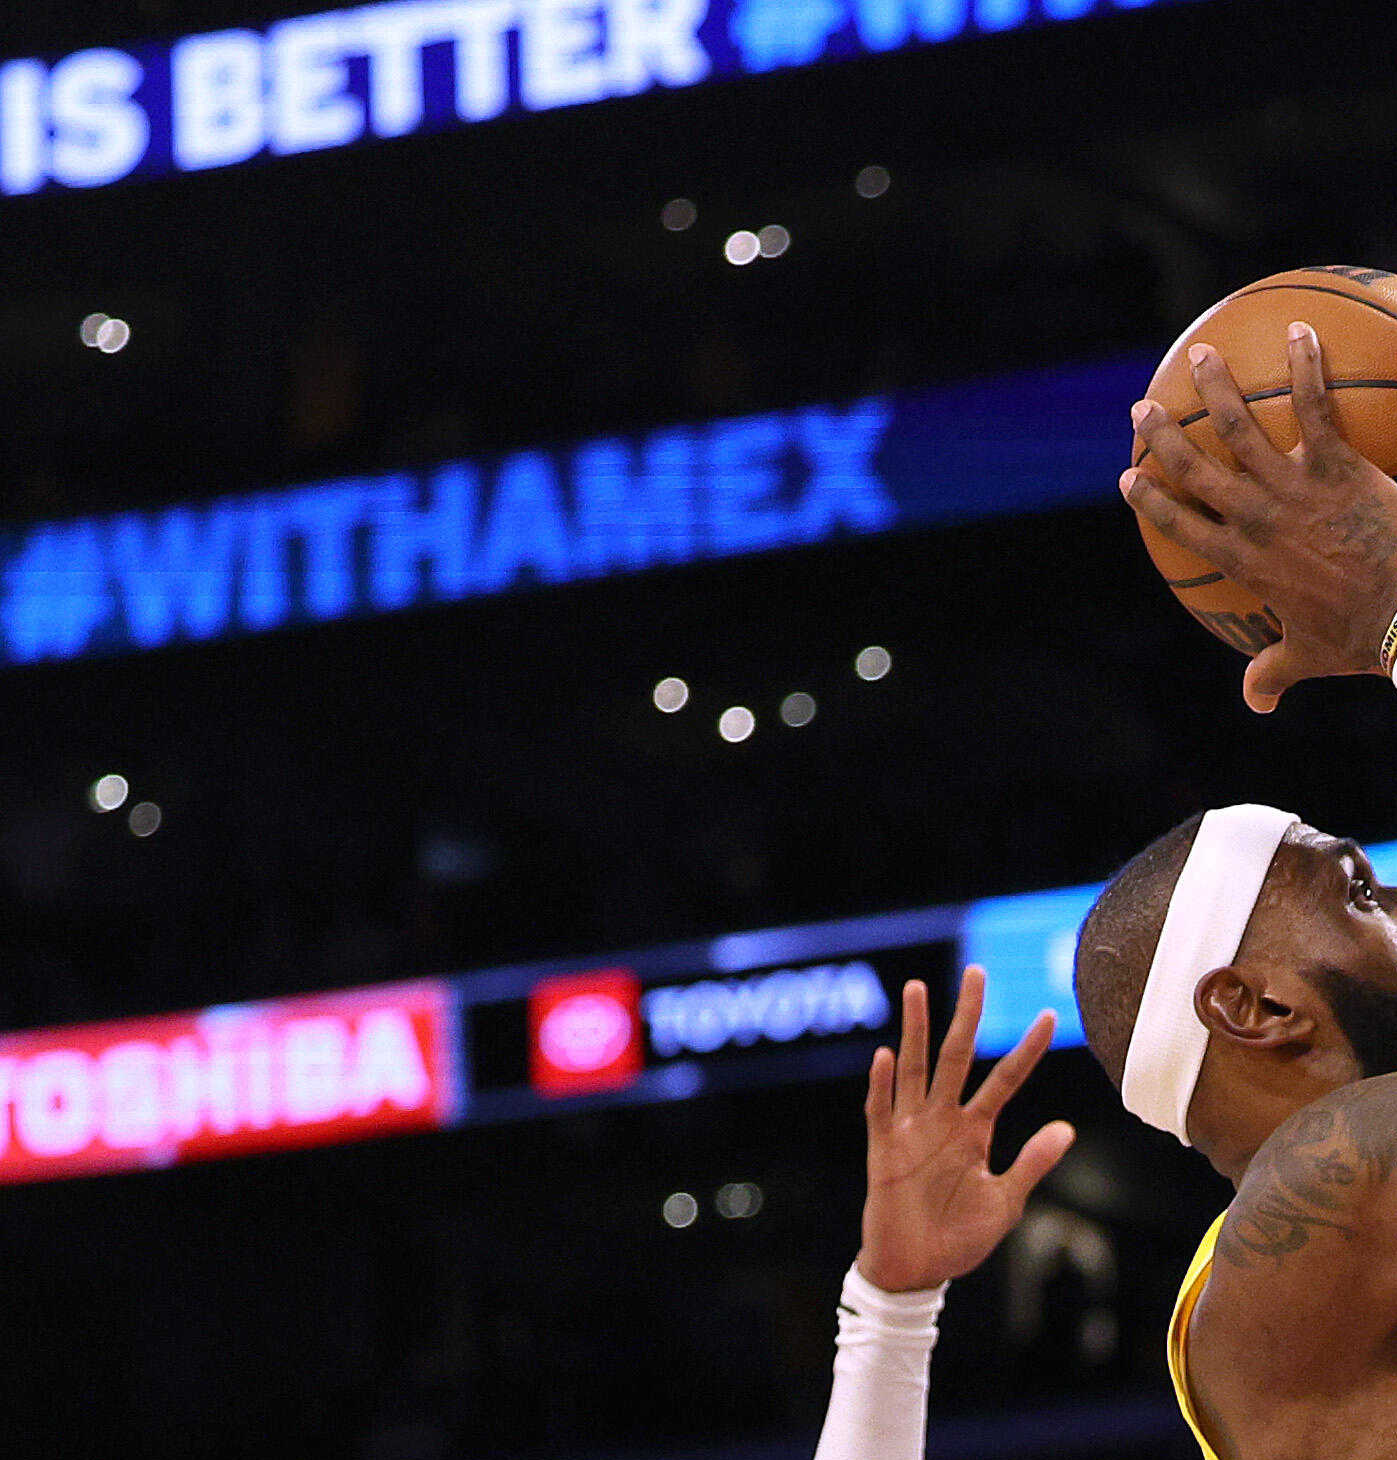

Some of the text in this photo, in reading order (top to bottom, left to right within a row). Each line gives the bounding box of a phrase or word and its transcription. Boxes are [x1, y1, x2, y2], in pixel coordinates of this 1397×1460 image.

[0, 48, 150, 194] IS
[171, 0, 711, 172] BETTER
[4, 398, 893, 664] #WITHAMEX
[645, 962, 886, 1054] TOYOTA
